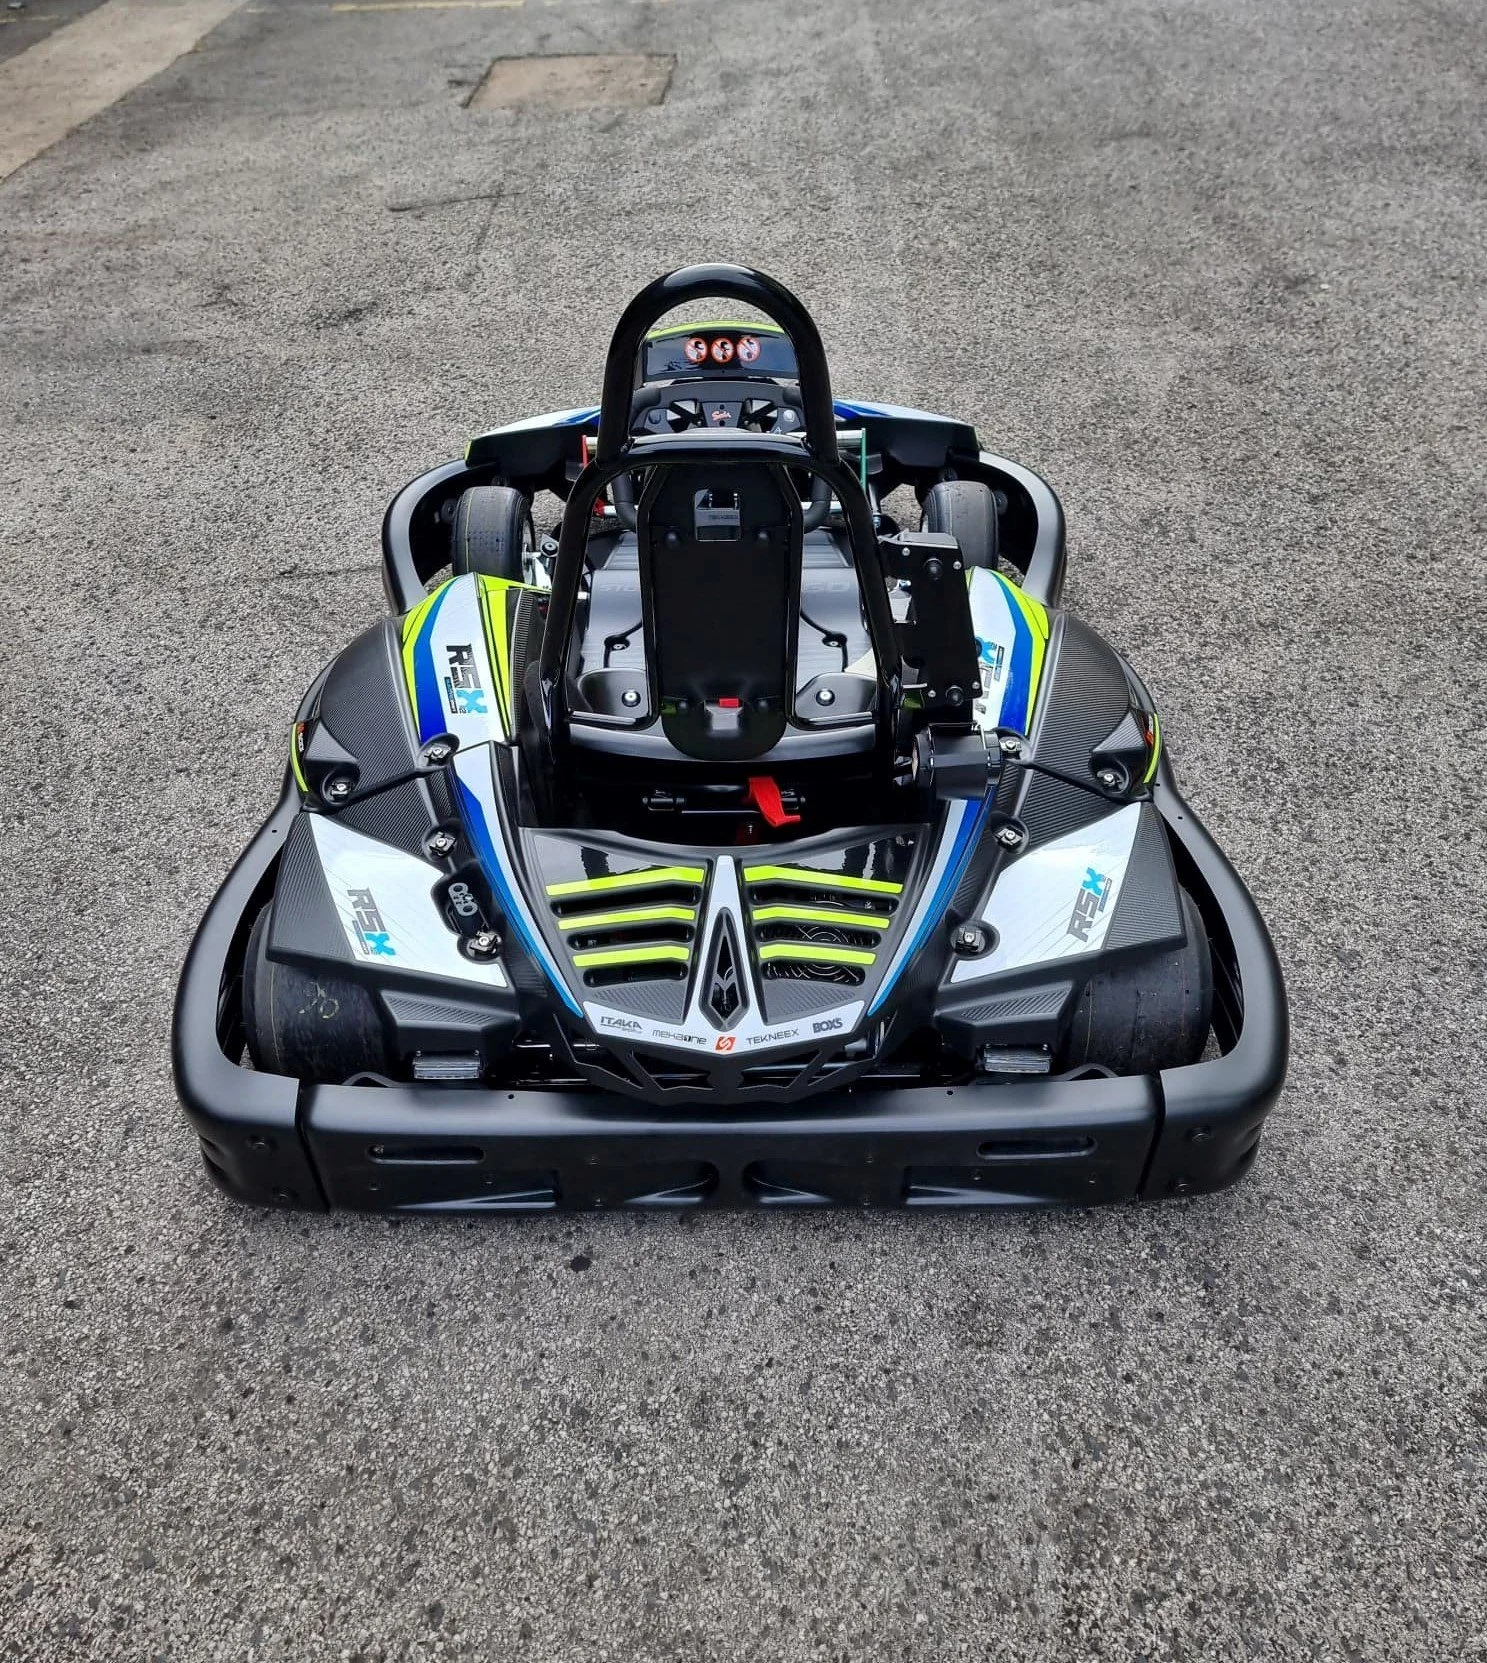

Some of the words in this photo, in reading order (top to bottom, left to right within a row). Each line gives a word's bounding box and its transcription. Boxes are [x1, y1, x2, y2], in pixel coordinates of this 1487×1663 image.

[347, 886, 397, 956] RSX
[1066, 867, 1103, 943] RSX
[600, 1016, 643, 1031] ITAKA
[746, 1028, 800, 1046] TEKNEEX
